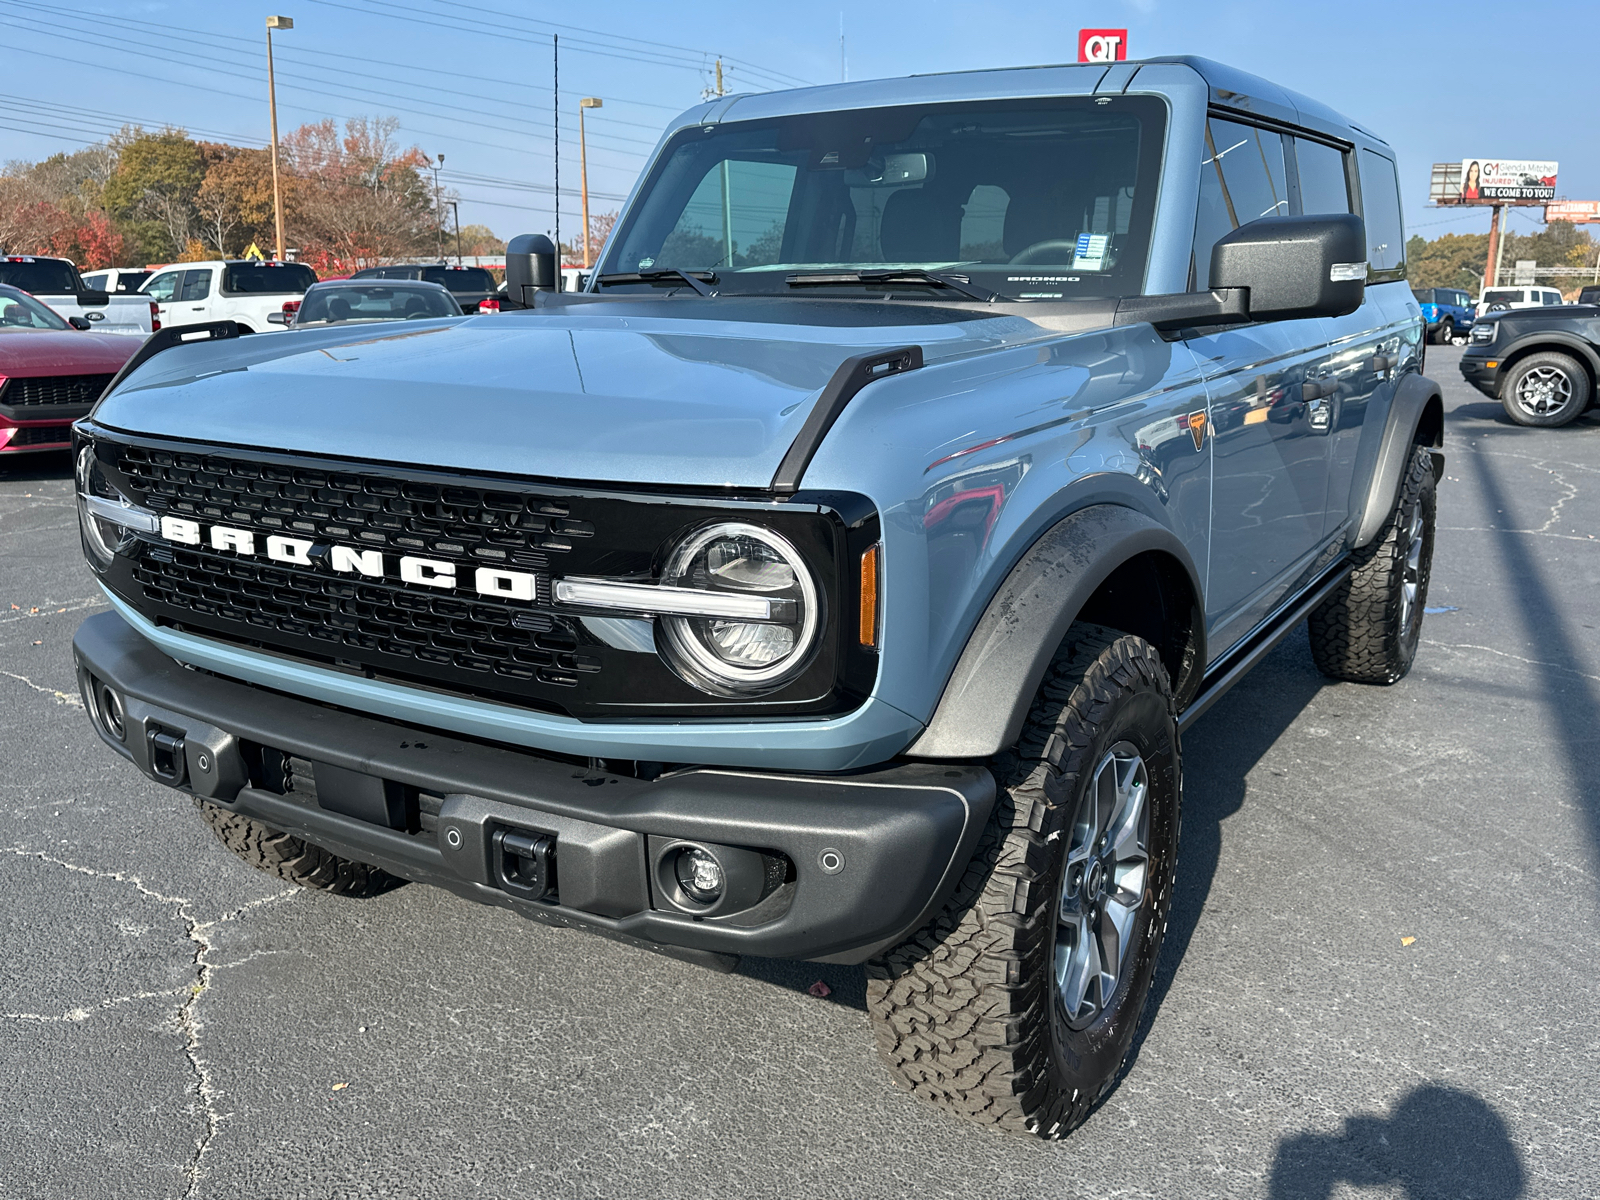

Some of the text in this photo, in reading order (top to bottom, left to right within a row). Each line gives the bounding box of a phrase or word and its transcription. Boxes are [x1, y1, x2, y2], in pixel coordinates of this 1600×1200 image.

[1085, 35, 1121, 62] QT
[1499, 162, 1556, 174] Glenda Mitchell
[1484, 187, 1553, 198] WE COME TO YOU!
[161, 515, 537, 601] BRONCO
